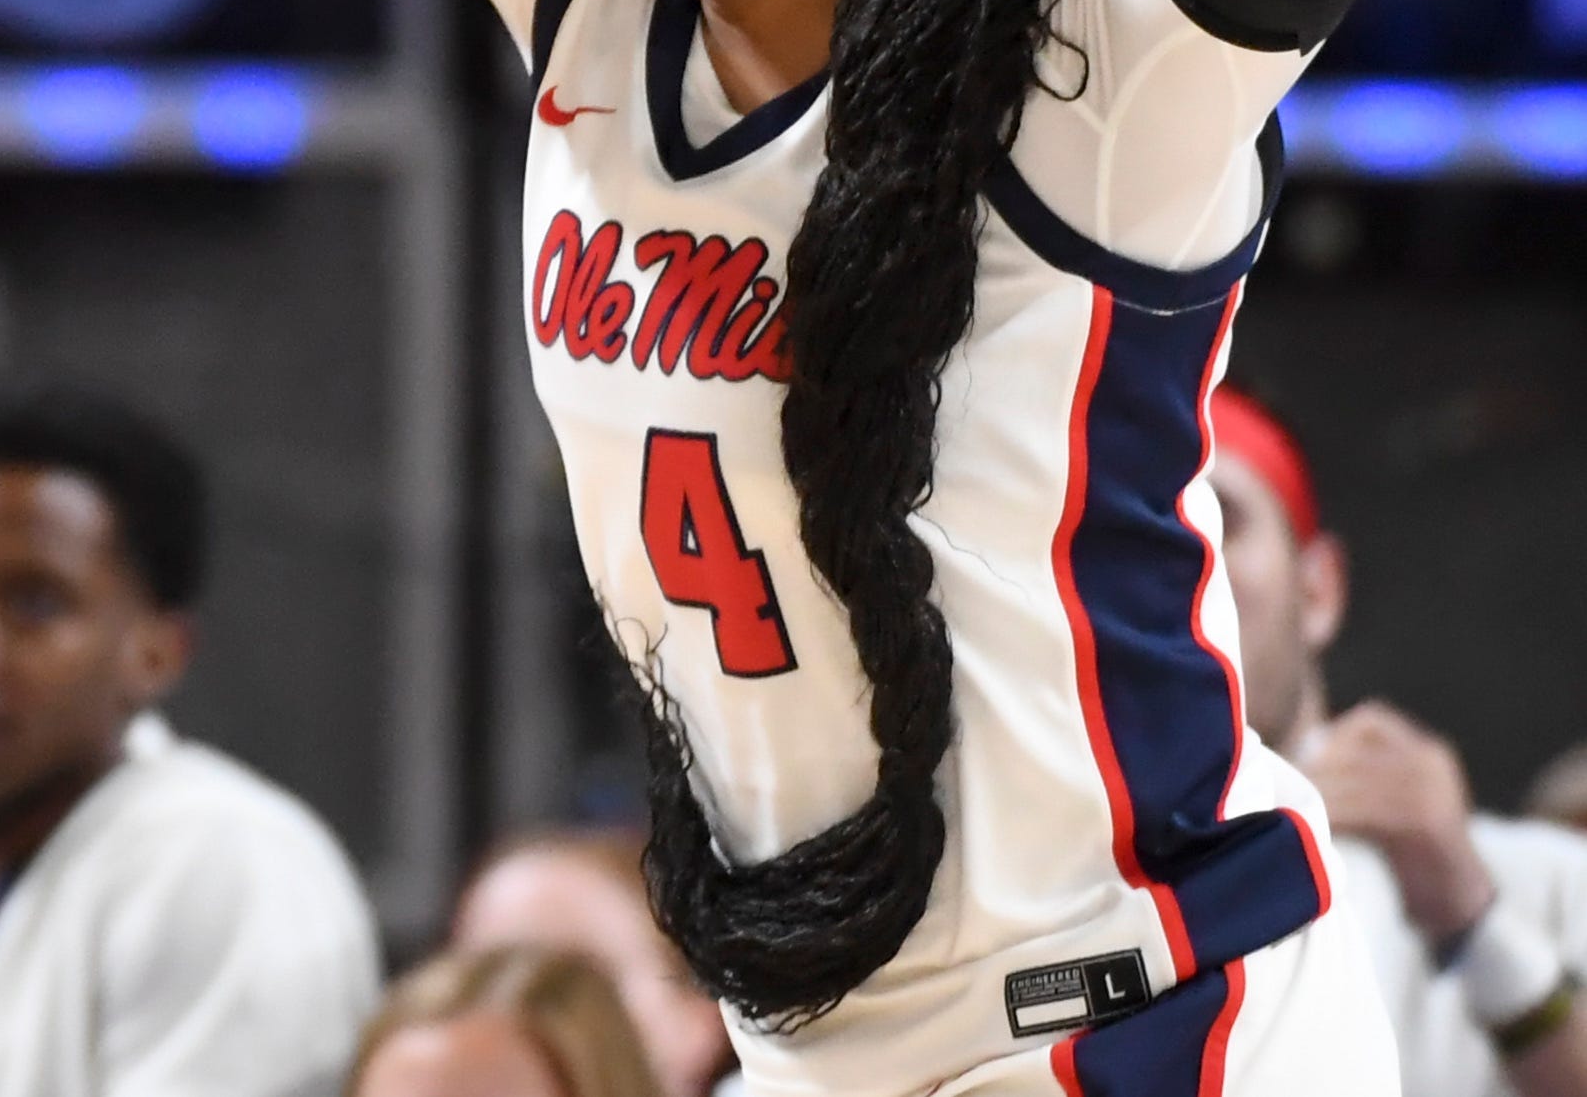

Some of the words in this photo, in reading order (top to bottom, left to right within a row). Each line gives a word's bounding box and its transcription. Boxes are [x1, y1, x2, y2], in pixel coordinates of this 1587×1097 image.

[531, 209, 635, 364] Ole
[639, 426, 799, 678] 4
[1104, 971, 1126, 1000] L
